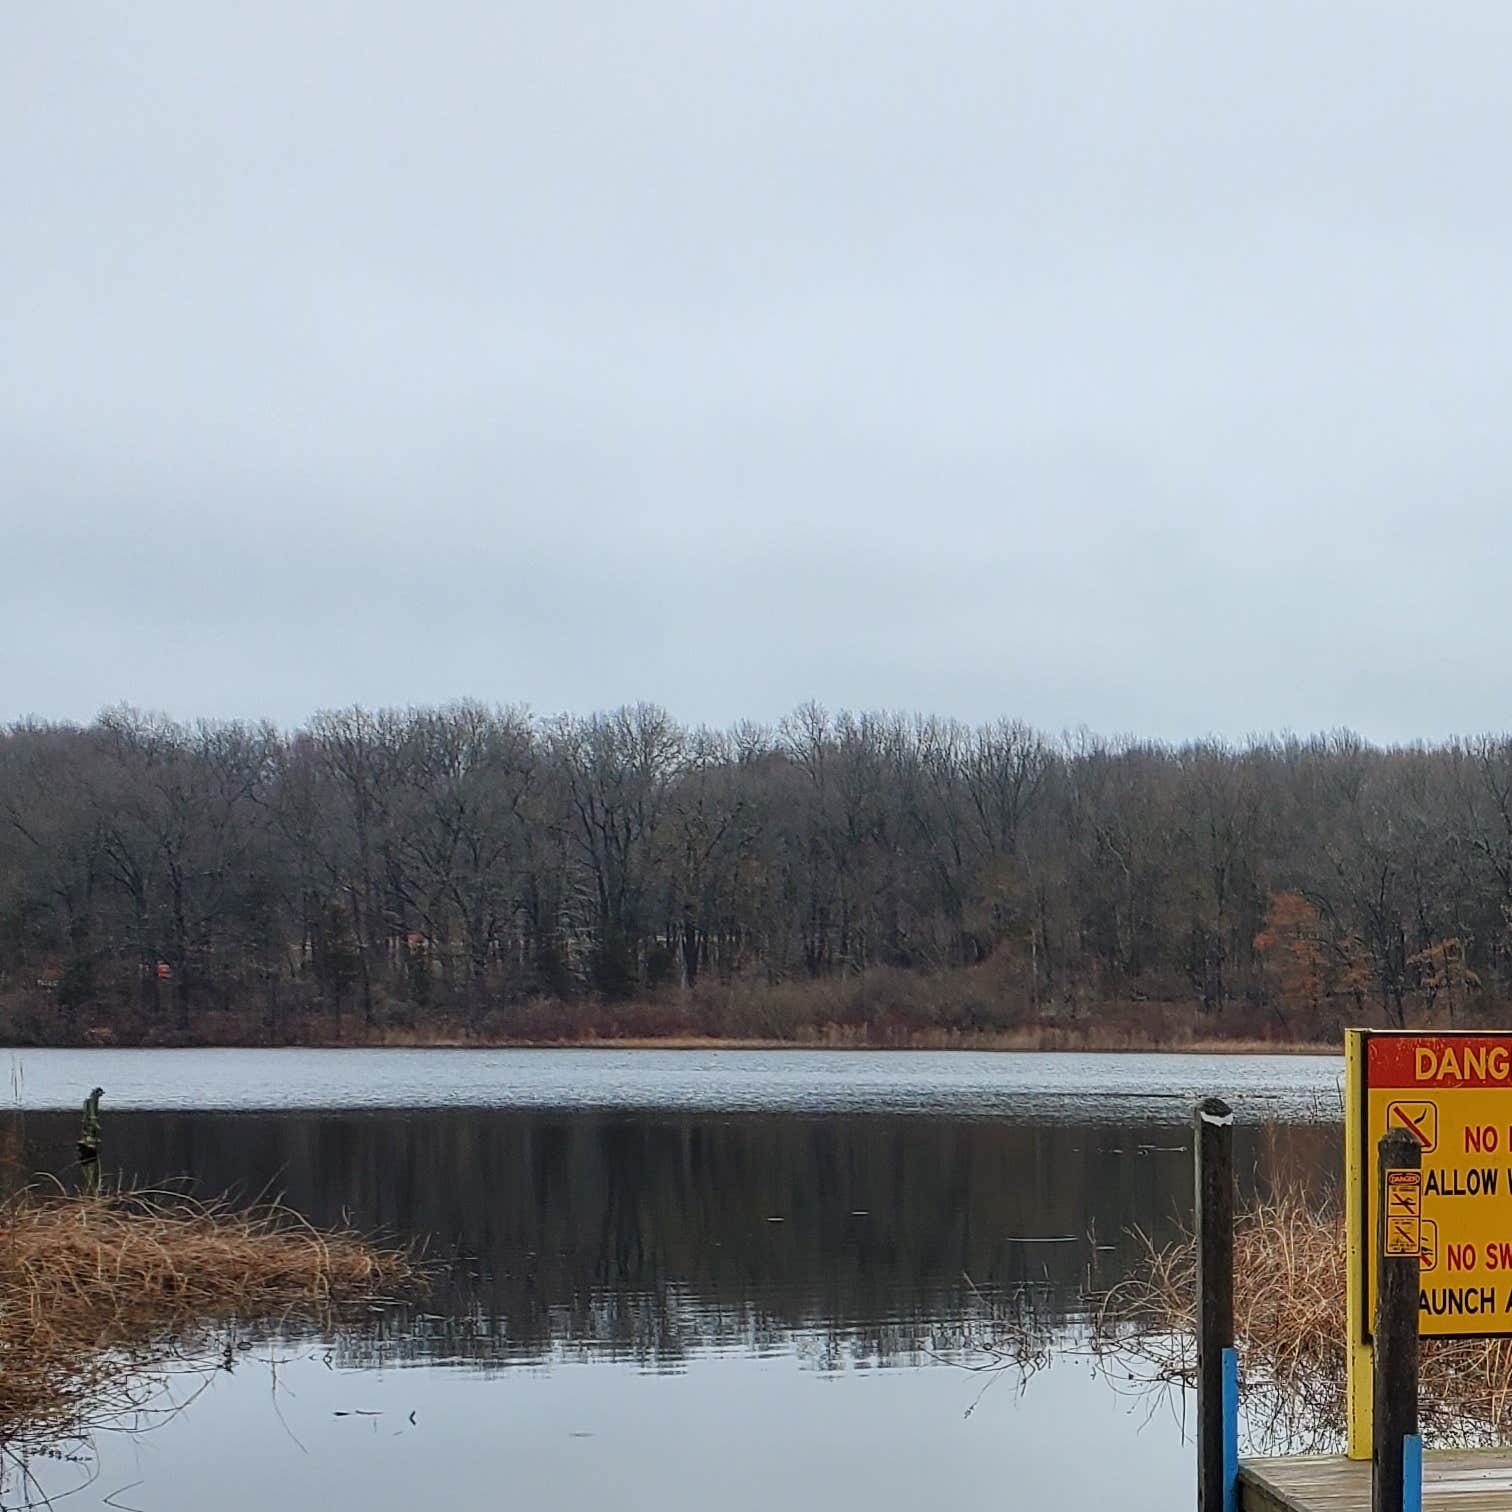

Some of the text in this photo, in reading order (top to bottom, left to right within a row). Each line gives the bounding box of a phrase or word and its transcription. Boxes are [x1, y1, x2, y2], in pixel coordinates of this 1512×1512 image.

[1464, 1126, 1498, 1153] NO
[1424, 1168, 1498, 1196] ALLOW
[1447, 1243, 1476, 1271] NO
[1419, 1287, 1495, 1315] AUNCH
